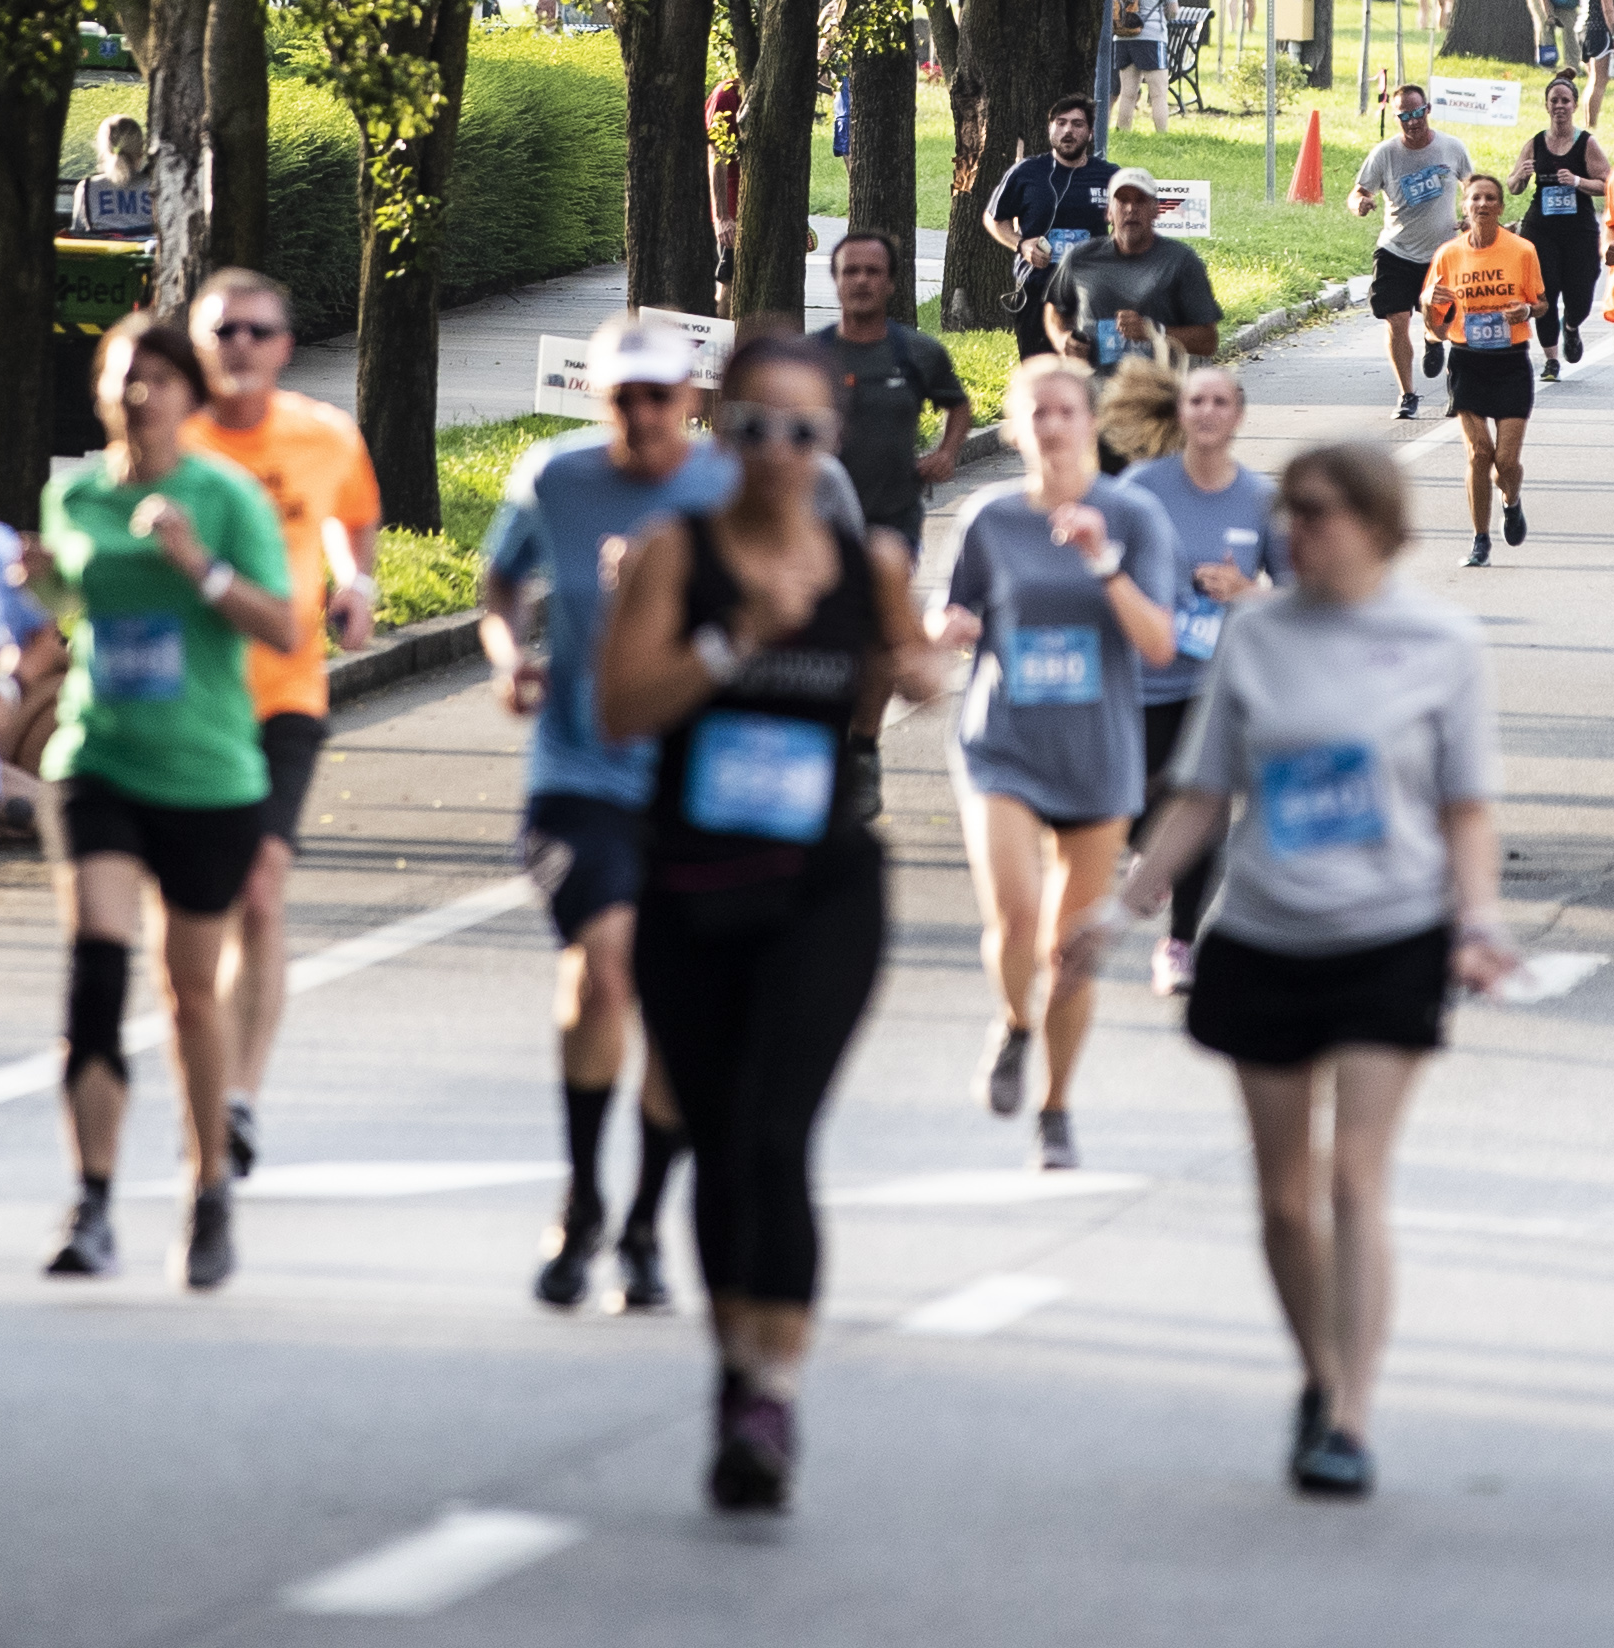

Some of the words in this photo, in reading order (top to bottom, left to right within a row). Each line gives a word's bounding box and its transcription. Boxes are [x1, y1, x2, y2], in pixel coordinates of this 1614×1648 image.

[1409, 178, 1434, 197] 570
[1547, 195, 1571, 207] 556
[1153, 221, 1184, 229] ational
[1185, 221, 1207, 230] Bank
[1462, 269, 1505, 285] DRIVE
[1455, 283, 1515, 300] ORANGE
[1472, 325, 1503, 340] 503
[564, 359, 587, 370] THAN
